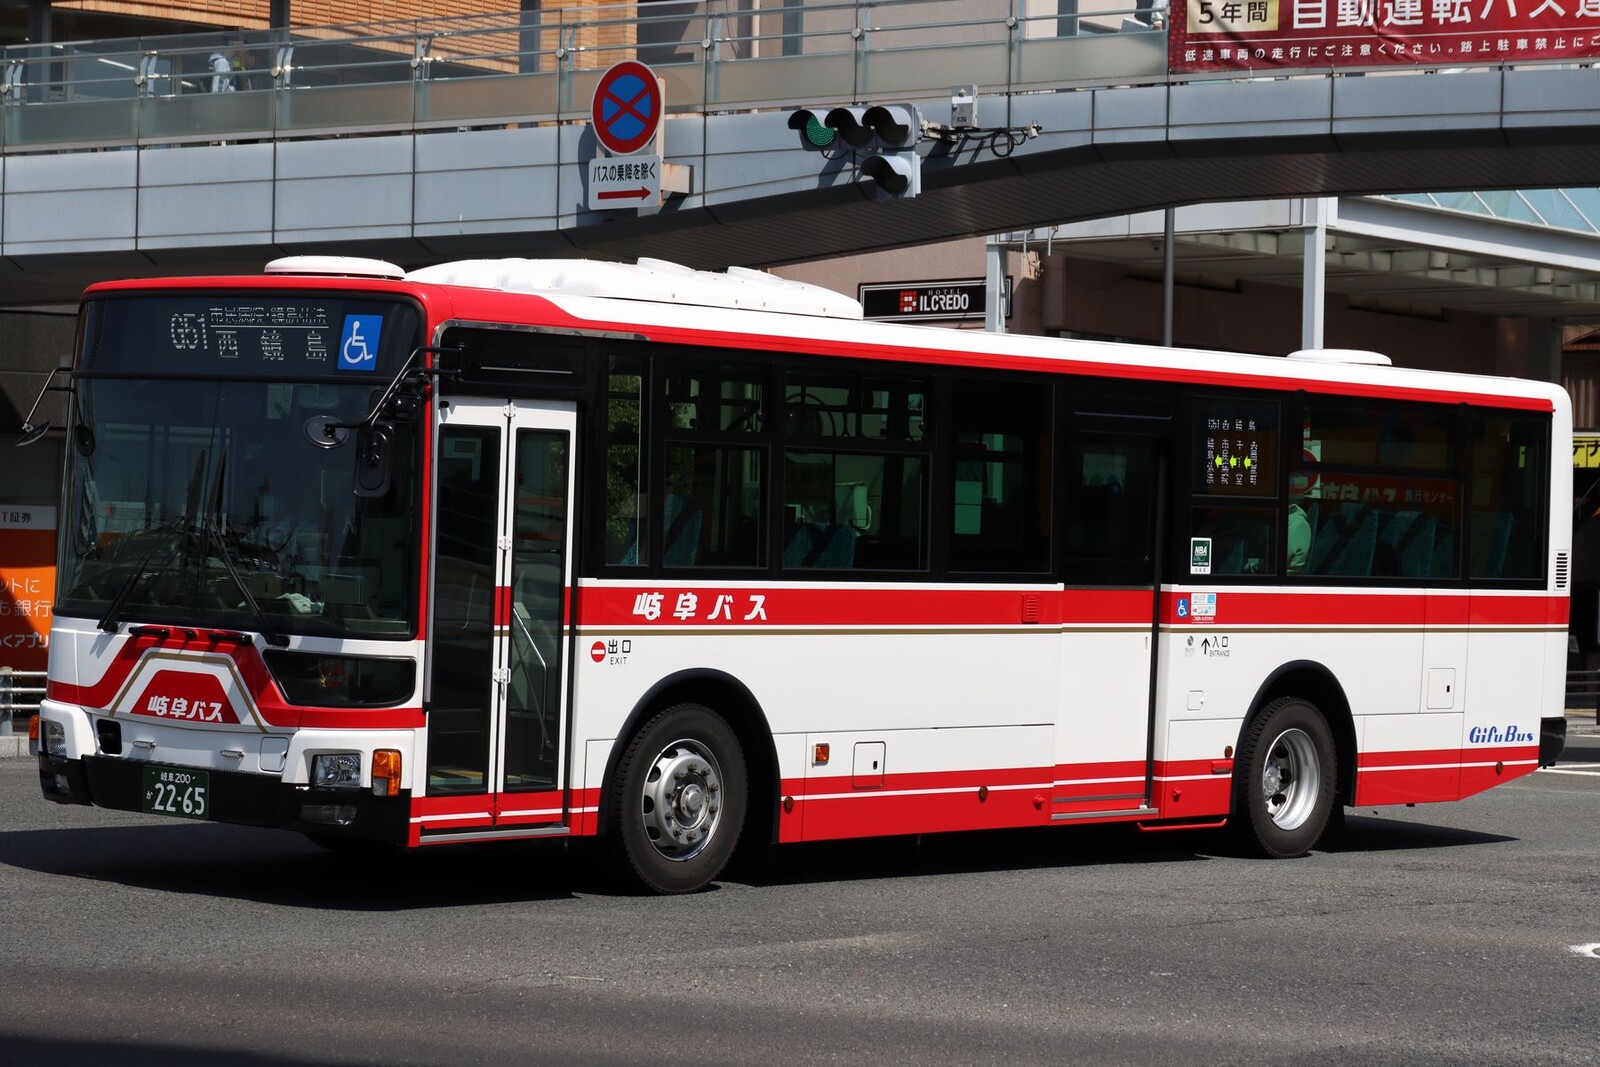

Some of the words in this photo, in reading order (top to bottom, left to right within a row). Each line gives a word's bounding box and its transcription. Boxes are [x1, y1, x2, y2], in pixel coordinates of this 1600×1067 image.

[1199, 1, 1268, 24] 5年間
[593, 162, 655, 182] バスの乗降を除く
[632, 591, 768, 621] 岐阜バス
[0, 631, 50, 648] くアプリ
[607, 638, 632, 654] 出口
[1211, 635, 1229, 648] 入口
[609, 656, 628, 665] EXIT
[147, 695, 223, 722] 岐阜バス
[1469, 725, 1503, 744] Gifu
[1504, 725, 1533, 742] Bus
